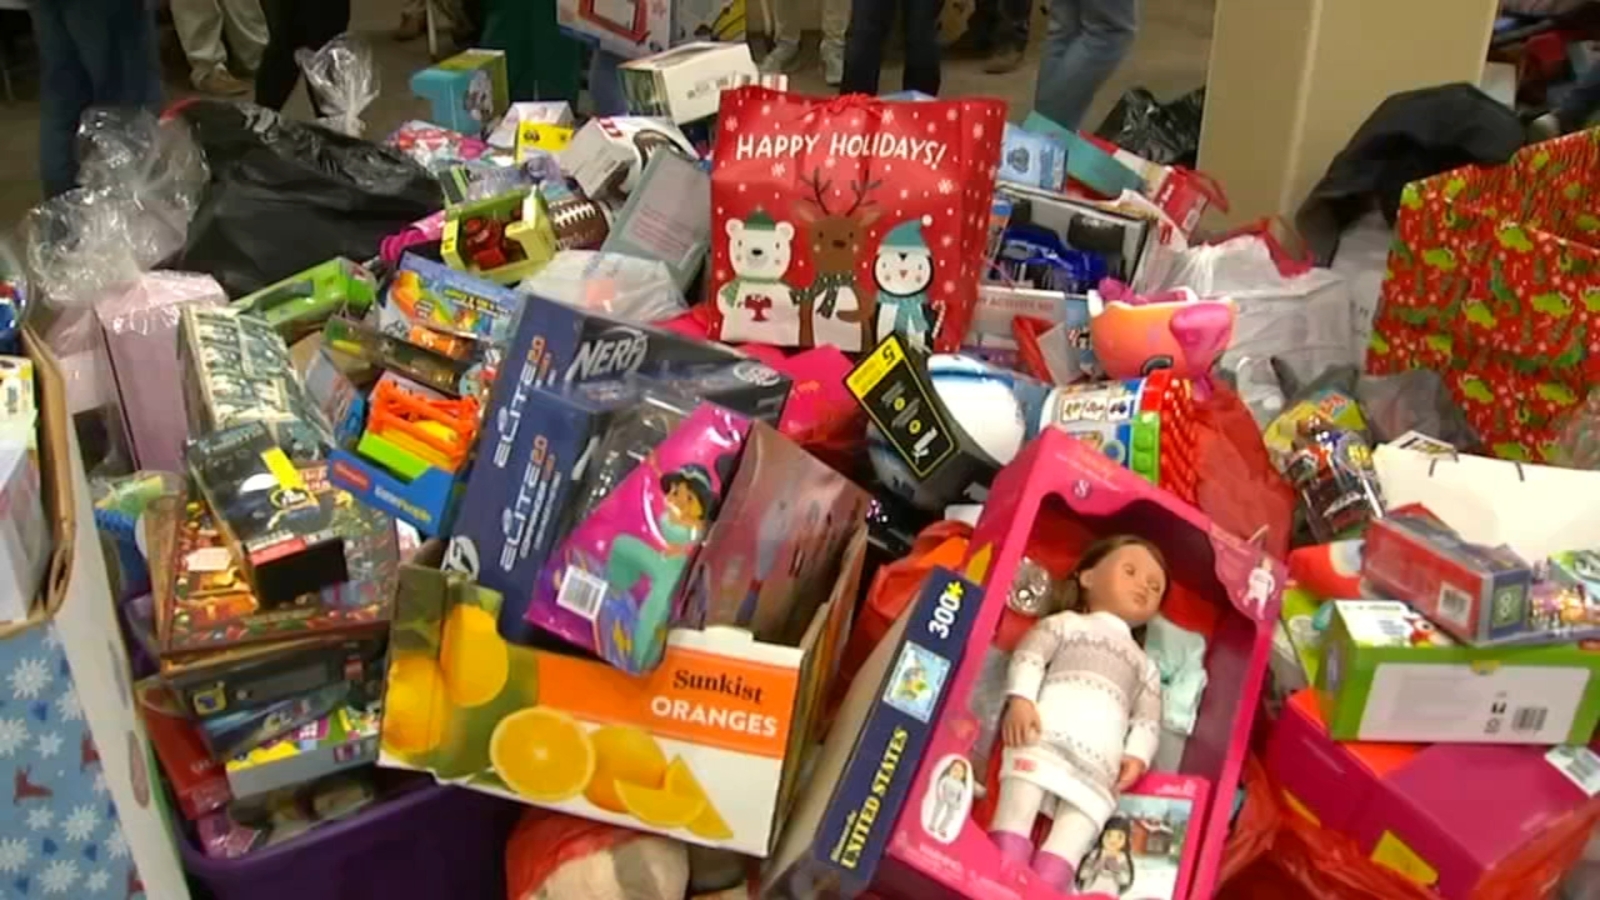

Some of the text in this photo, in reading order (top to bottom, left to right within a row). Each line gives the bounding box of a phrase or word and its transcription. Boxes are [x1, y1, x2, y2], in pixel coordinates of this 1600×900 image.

[736, 132, 947, 170] HAPPY HOLIDAYS!
[565, 332, 648, 381] NERF
[500, 461, 543, 572] ELITE
[929, 591, 962, 639] 300
[673, 669, 763, 704] Sunkist
[651, 696, 778, 738] ORANGES
[840, 795, 881, 870] UNITED
[871, 726, 909, 794] STATES
